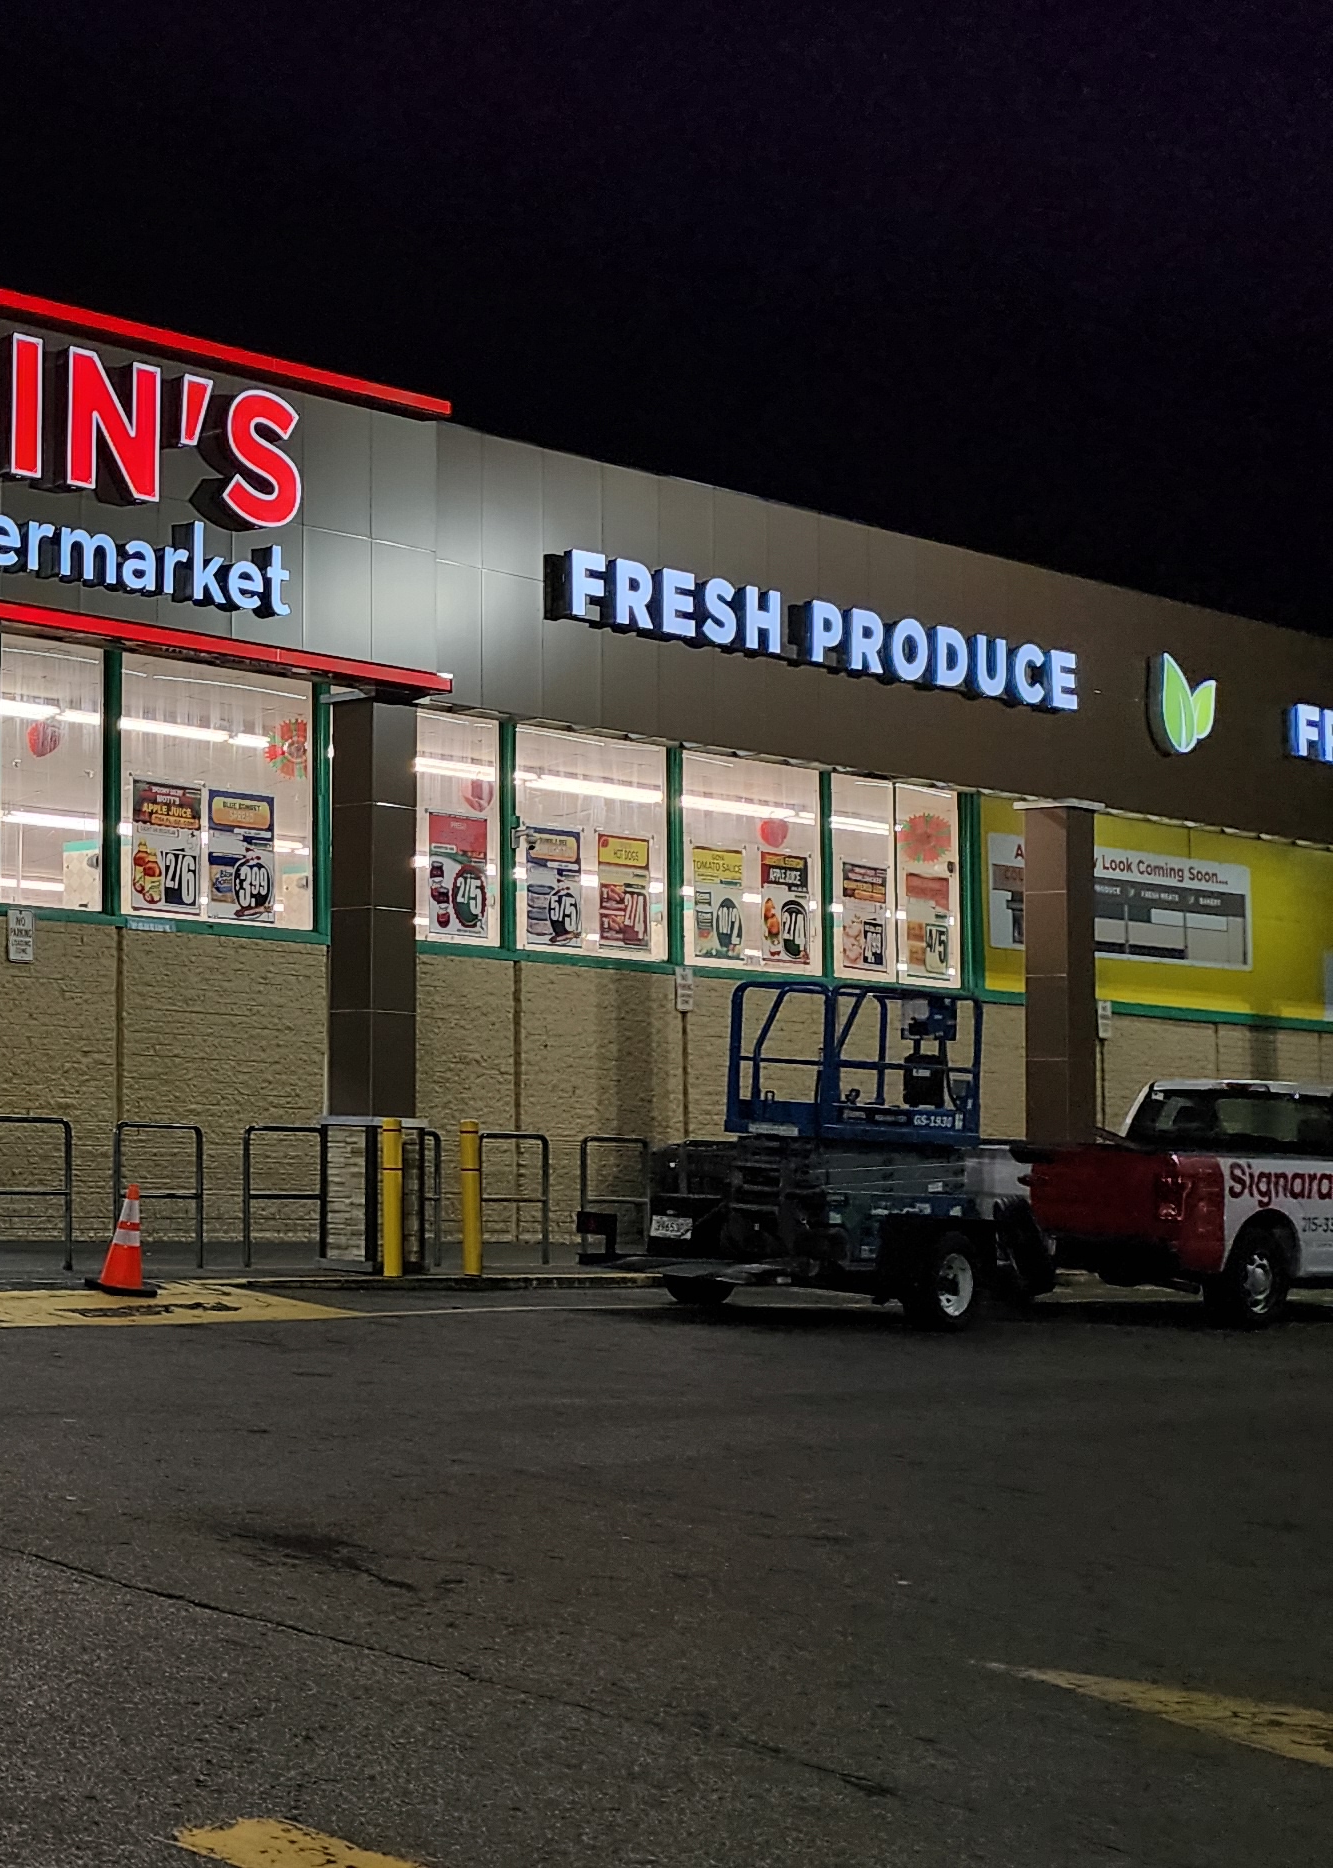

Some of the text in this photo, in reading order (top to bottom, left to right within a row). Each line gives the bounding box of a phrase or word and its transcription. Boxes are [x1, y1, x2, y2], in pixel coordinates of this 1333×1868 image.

[567, 548, 1079, 711] FRESH PRODUCE
[142, 802, 193, 818] APPLE JUICE
[165, 852, 196, 905] 2/6
[693, 859, 721, 872] TOMATO
[1102, 854, 1134, 873] Look
[1137, 859, 1184, 883] Coming
[235, 865, 269, 908] $3.99
[456, 876, 483, 915] 2/5
[550, 895, 577, 931] 5/5
[782, 911, 805, 951] 2/4
